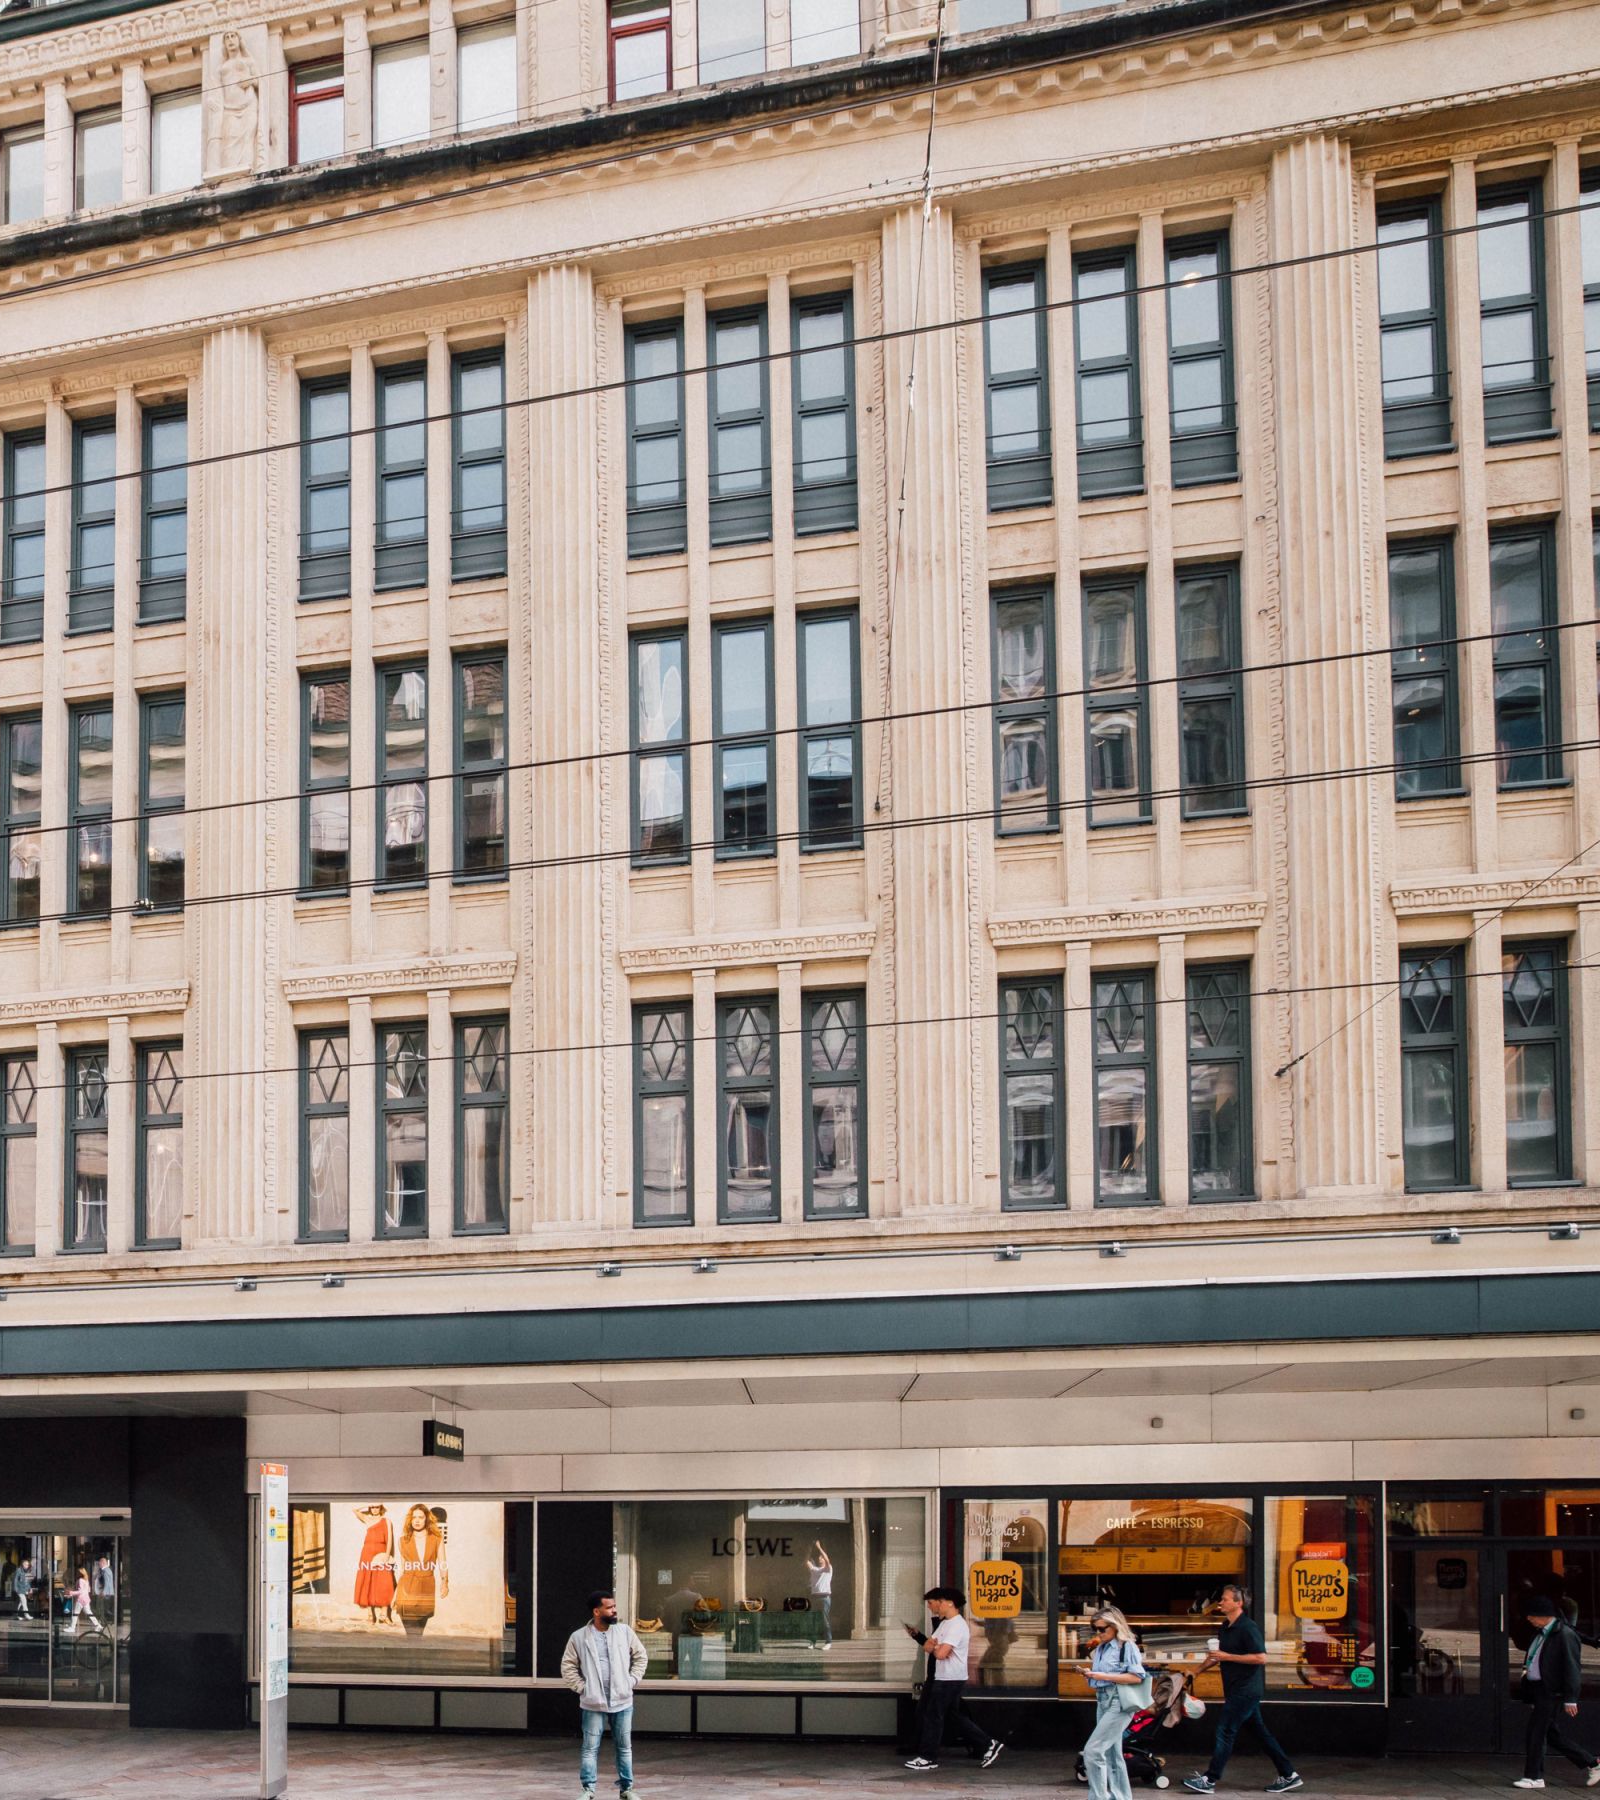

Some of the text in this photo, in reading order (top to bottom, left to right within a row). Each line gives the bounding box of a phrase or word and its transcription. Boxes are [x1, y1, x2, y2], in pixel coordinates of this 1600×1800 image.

[436, 1431, 463, 1451] GLOBUS
[1151, 1517, 1204, 1529] ESPRESSO
[712, 1537, 794, 1557] LOEWE
[974, 1569, 1020, 1597] Nero's
[1295, 1569, 1345, 1597] Nero's
[976, 1586, 1008, 1603] pizza
[1298, 1585, 1332, 1603] pizza
